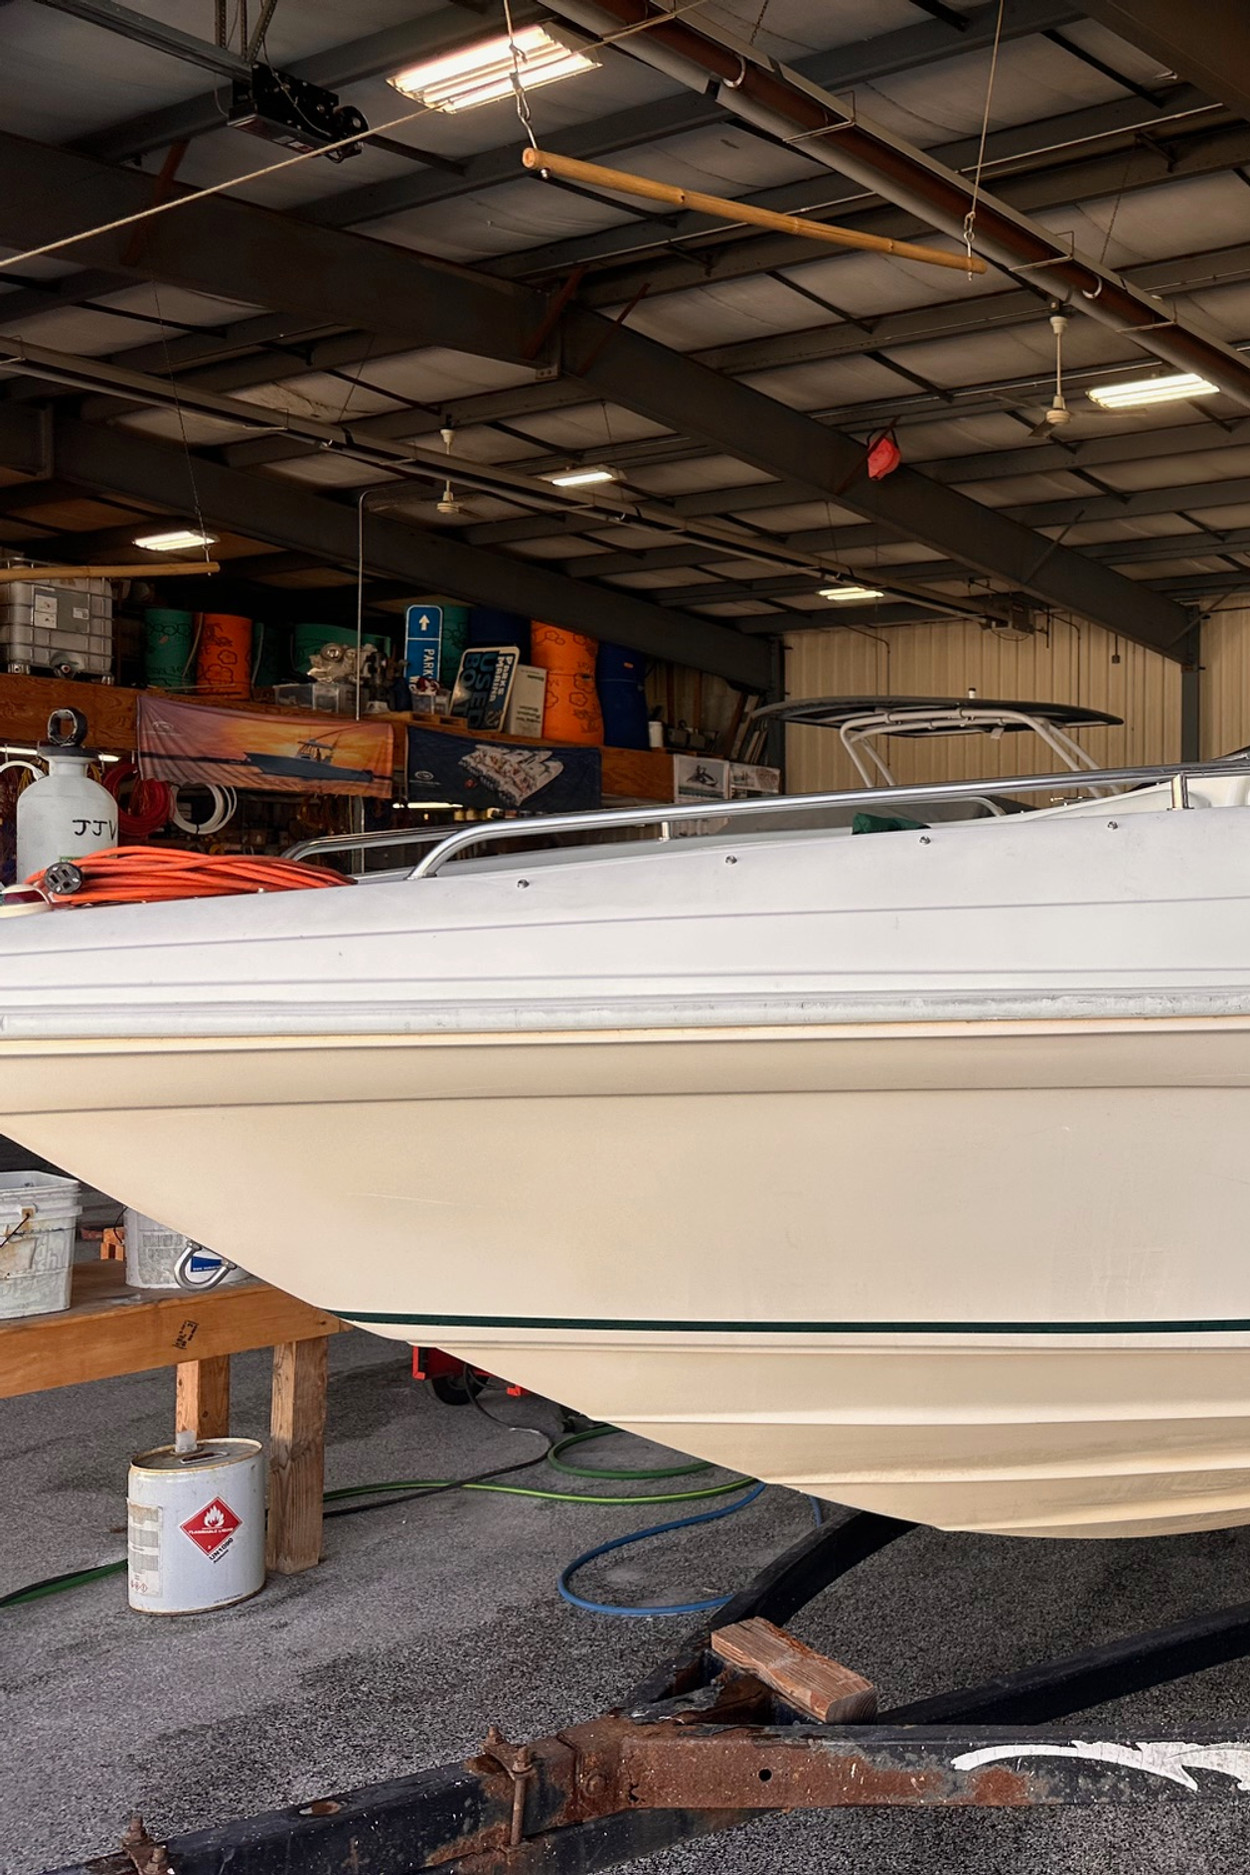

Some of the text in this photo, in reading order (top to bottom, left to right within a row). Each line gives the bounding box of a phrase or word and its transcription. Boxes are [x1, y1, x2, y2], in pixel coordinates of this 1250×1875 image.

[423, 648, 435, 680] PARK
[452, 653, 480, 717] BOAT
[468, 652, 499, 729] USED
